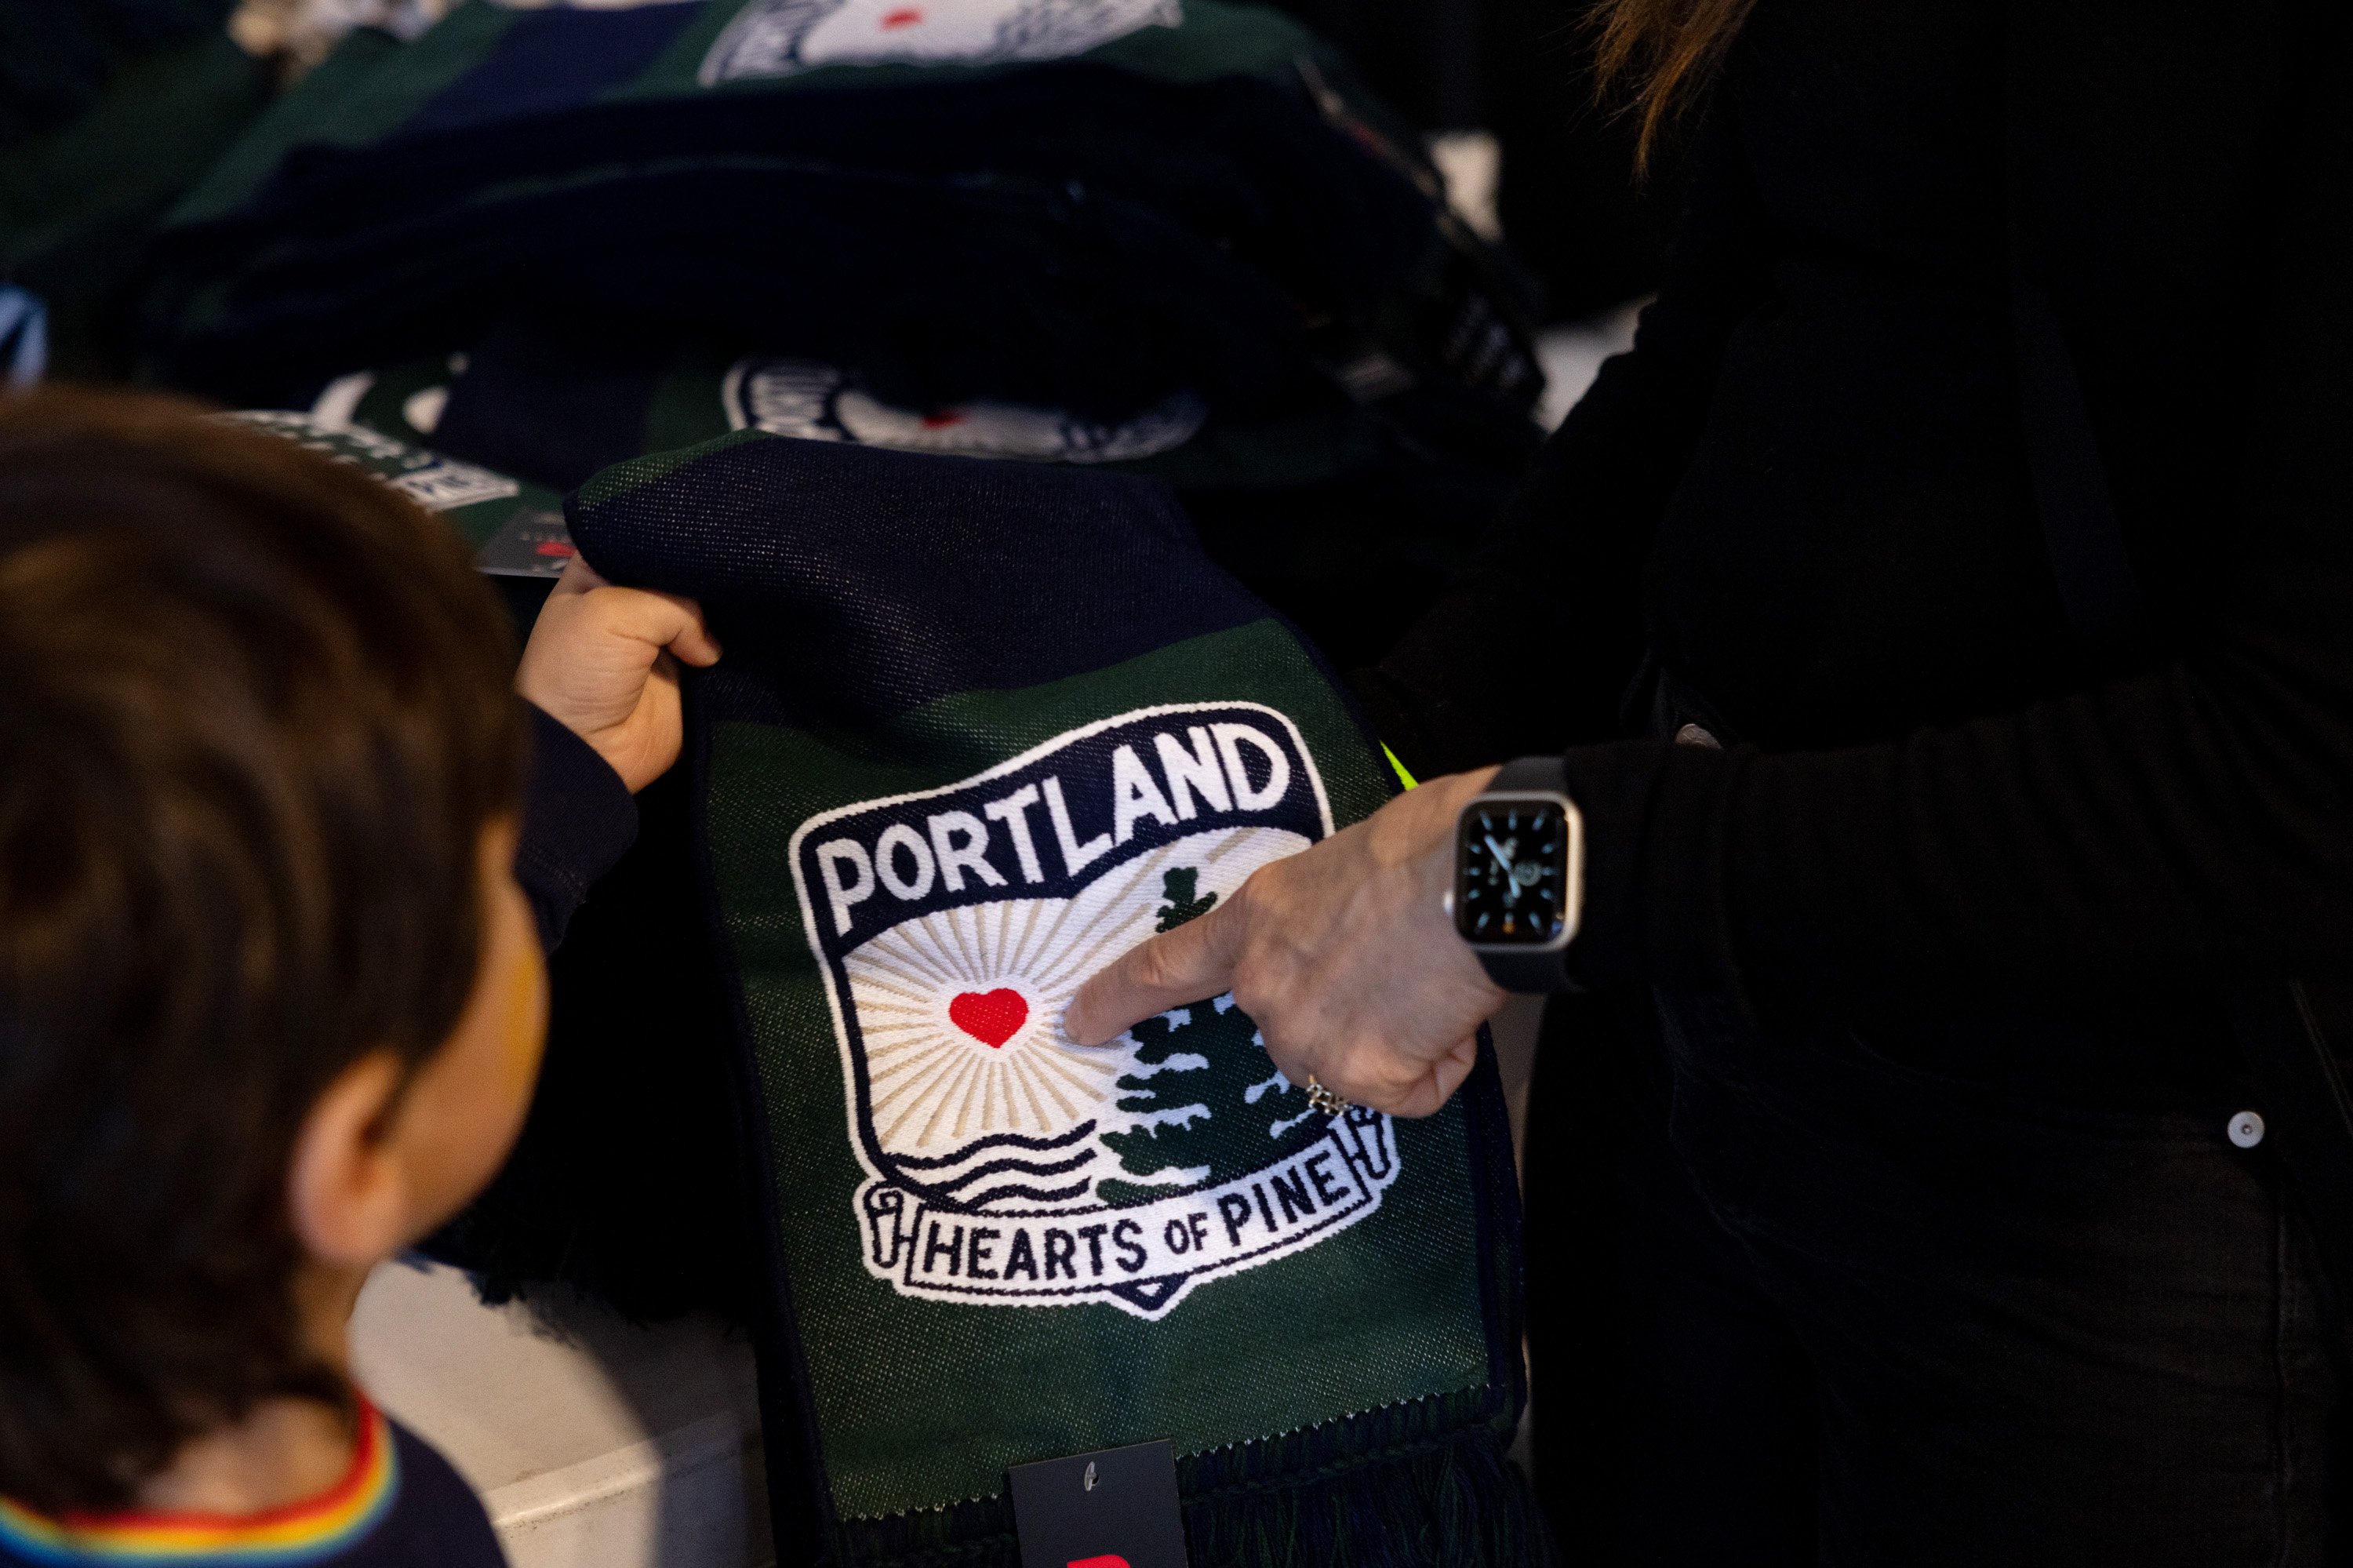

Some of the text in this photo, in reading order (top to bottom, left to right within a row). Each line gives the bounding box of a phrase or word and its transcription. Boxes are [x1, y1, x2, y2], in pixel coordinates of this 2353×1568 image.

[816, 723, 1290, 938] PORTLAND
[923, 1149, 1350, 1280] HEARTS OF PINE
